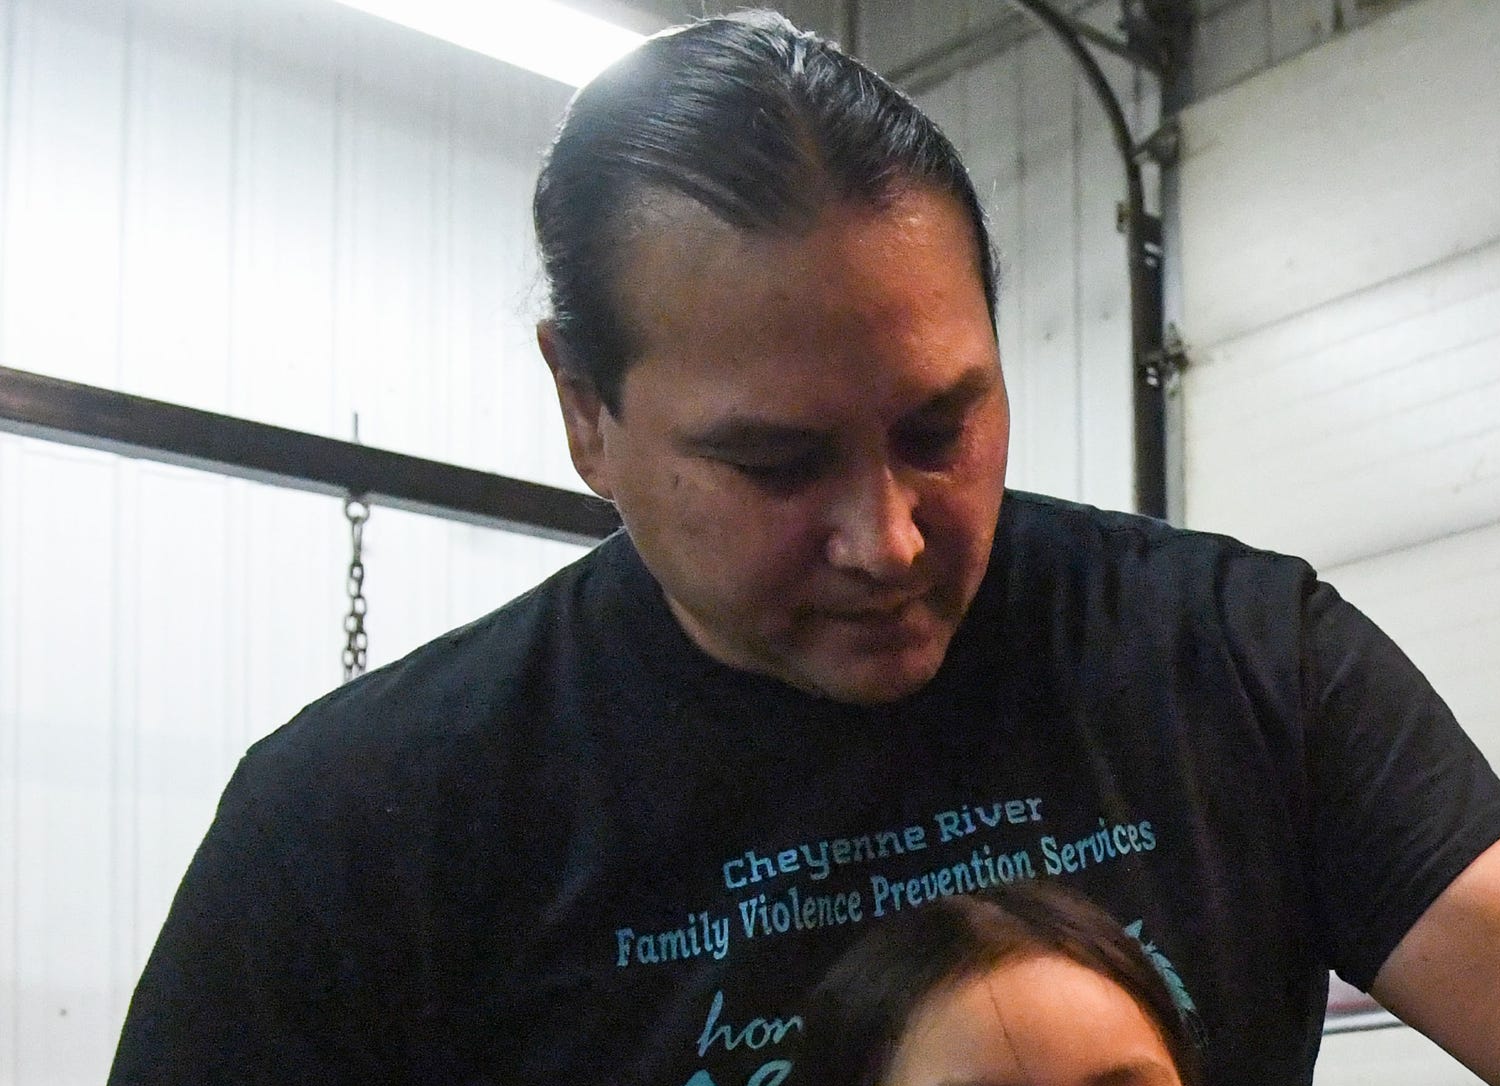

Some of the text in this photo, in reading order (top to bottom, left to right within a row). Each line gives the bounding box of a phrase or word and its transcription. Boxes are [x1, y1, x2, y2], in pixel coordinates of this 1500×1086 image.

[615, 816, 1158, 968] Family Violence Prevention Services
[722, 797, 1043, 889] Cheyenne River
